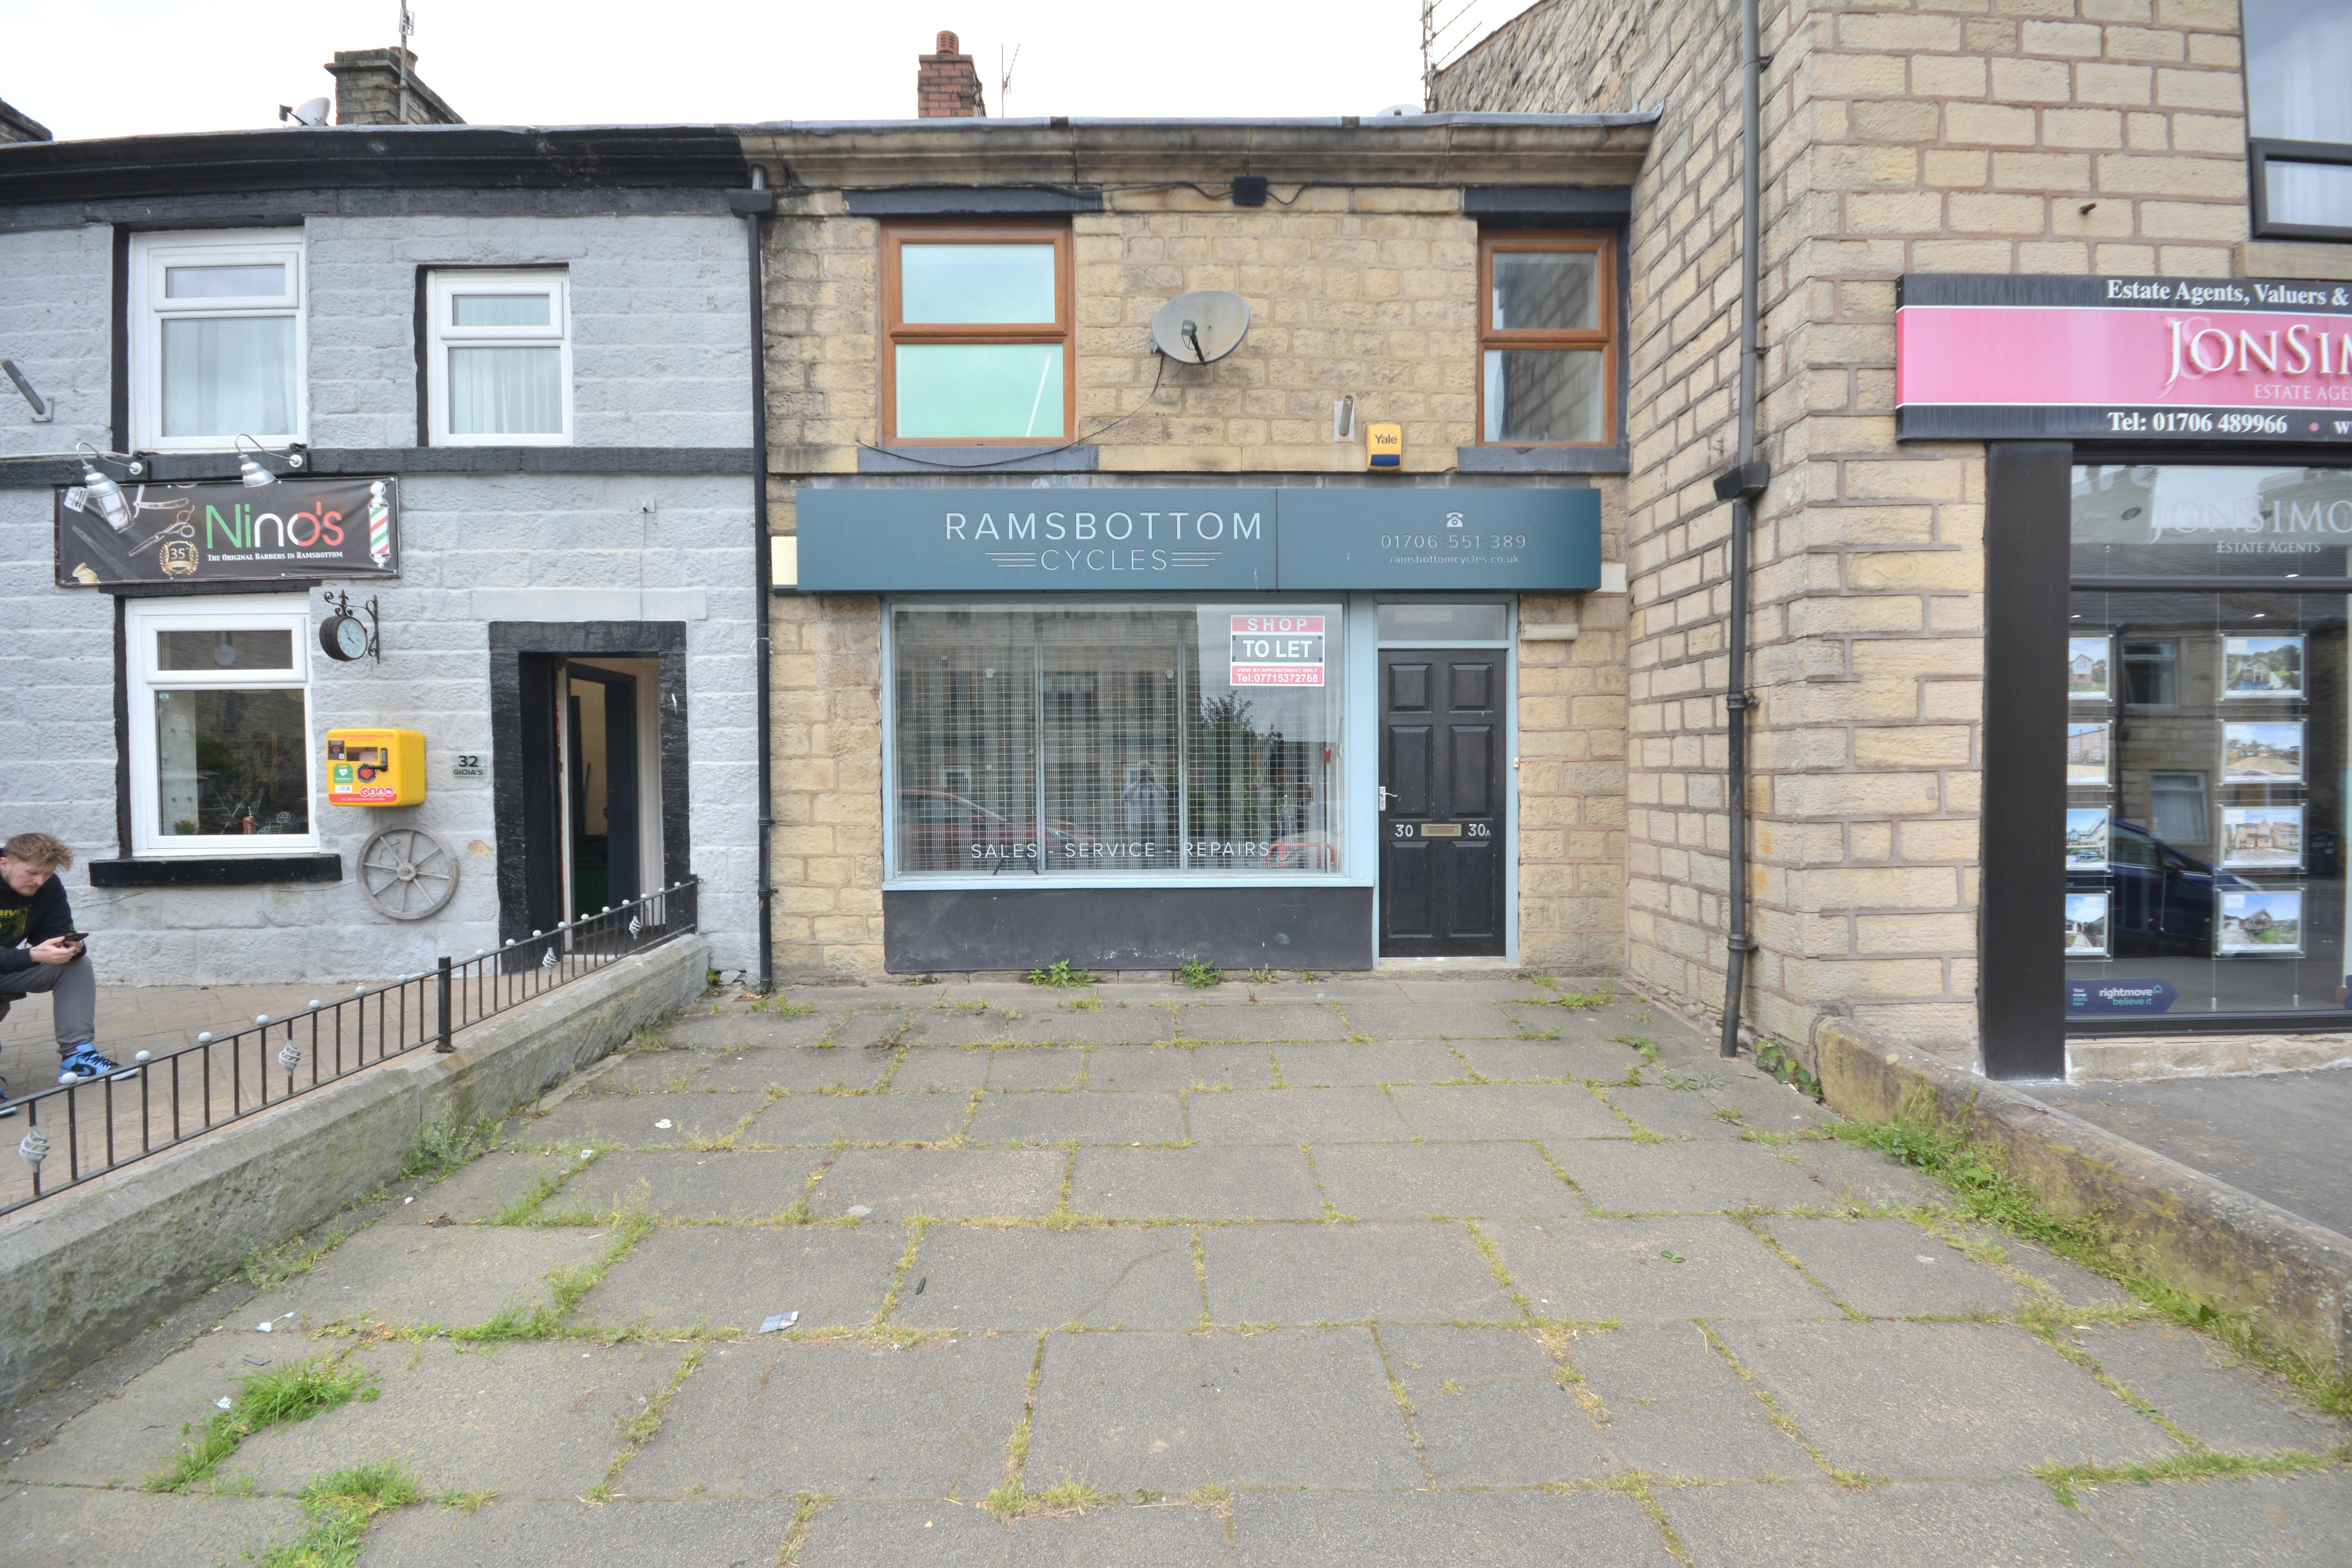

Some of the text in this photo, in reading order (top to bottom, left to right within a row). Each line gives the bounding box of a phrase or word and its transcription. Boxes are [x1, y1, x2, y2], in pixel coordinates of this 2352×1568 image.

[2107, 279, 2350, 306] Estate Agents, Valuers &
[2254, 384, 2352, 401] ESTATE AGE
[2107, 412, 2147, 431] Tel:
[2153, 413, 2213, 432] 01706
[2218, 413, 2288, 434] 489966
[1374, 434, 1397, 444] Yale
[206, 501, 345, 549] Nino's
[946, 511, 1260, 540] RAMSBOTTOM
[1381, 534, 1526, 548] 01706-551-389
[2219, 541, 2321, 554] ESTATE AGENTS
[1041, 549, 1167, 571] CYCLES
[1390, 555, 1519, 564] ramsbottomcycles.co.uk
[1247, 618, 1307, 631] SHOP
[1243, 640, 1312, 658] TO LET
[1236, 673, 1318, 683] Tel:07715372768
[458, 755, 478, 768] 32
[1395, 824, 1491, 837] 30 30A
[971, 844, 1037, 858] SALES
[1065, 842, 1155, 857] SERVICE
[1183, 842, 1269, 856] REPAIRS
[2099, 987, 2153, 999] rightmove
